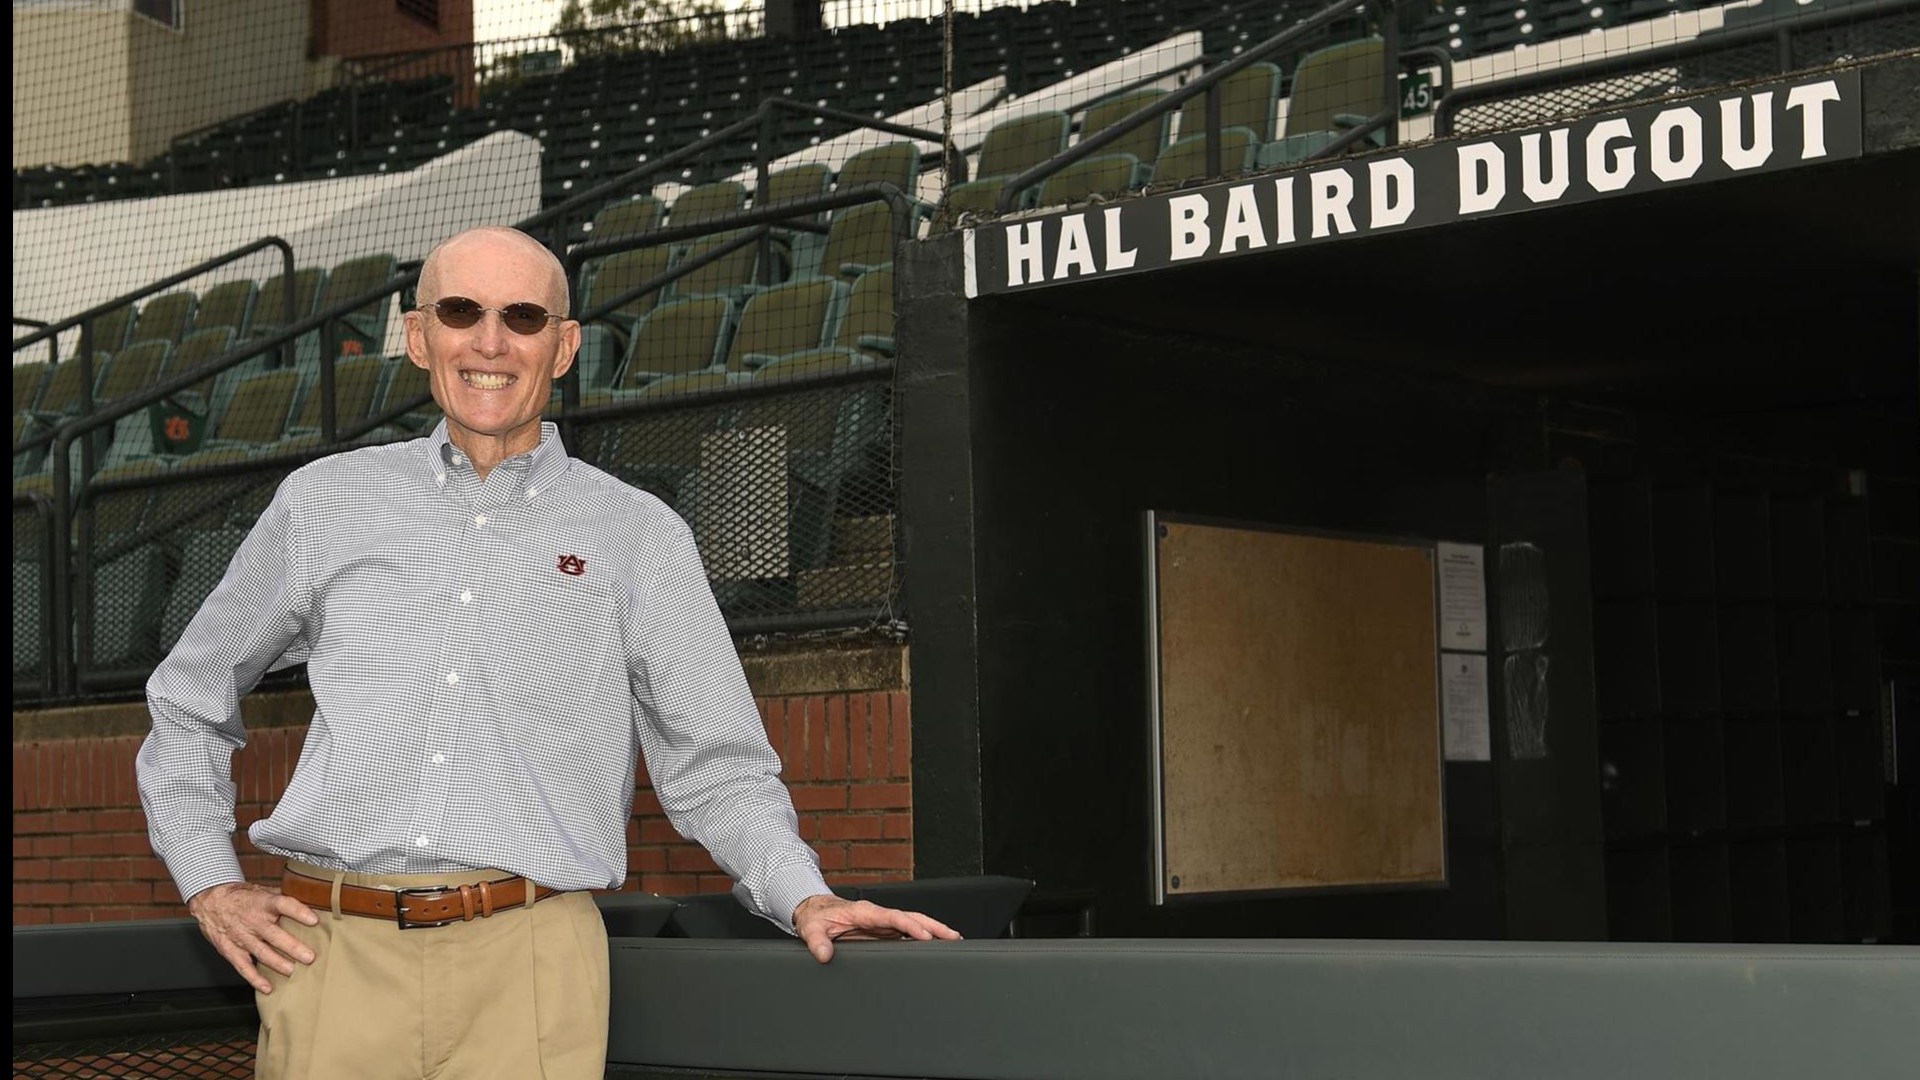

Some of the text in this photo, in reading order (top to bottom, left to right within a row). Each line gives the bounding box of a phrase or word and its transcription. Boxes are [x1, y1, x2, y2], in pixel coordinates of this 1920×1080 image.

[1403, 83, 1429, 109] 45
[1005, 80, 1841, 287] HAL BAIRD DUGOUT
